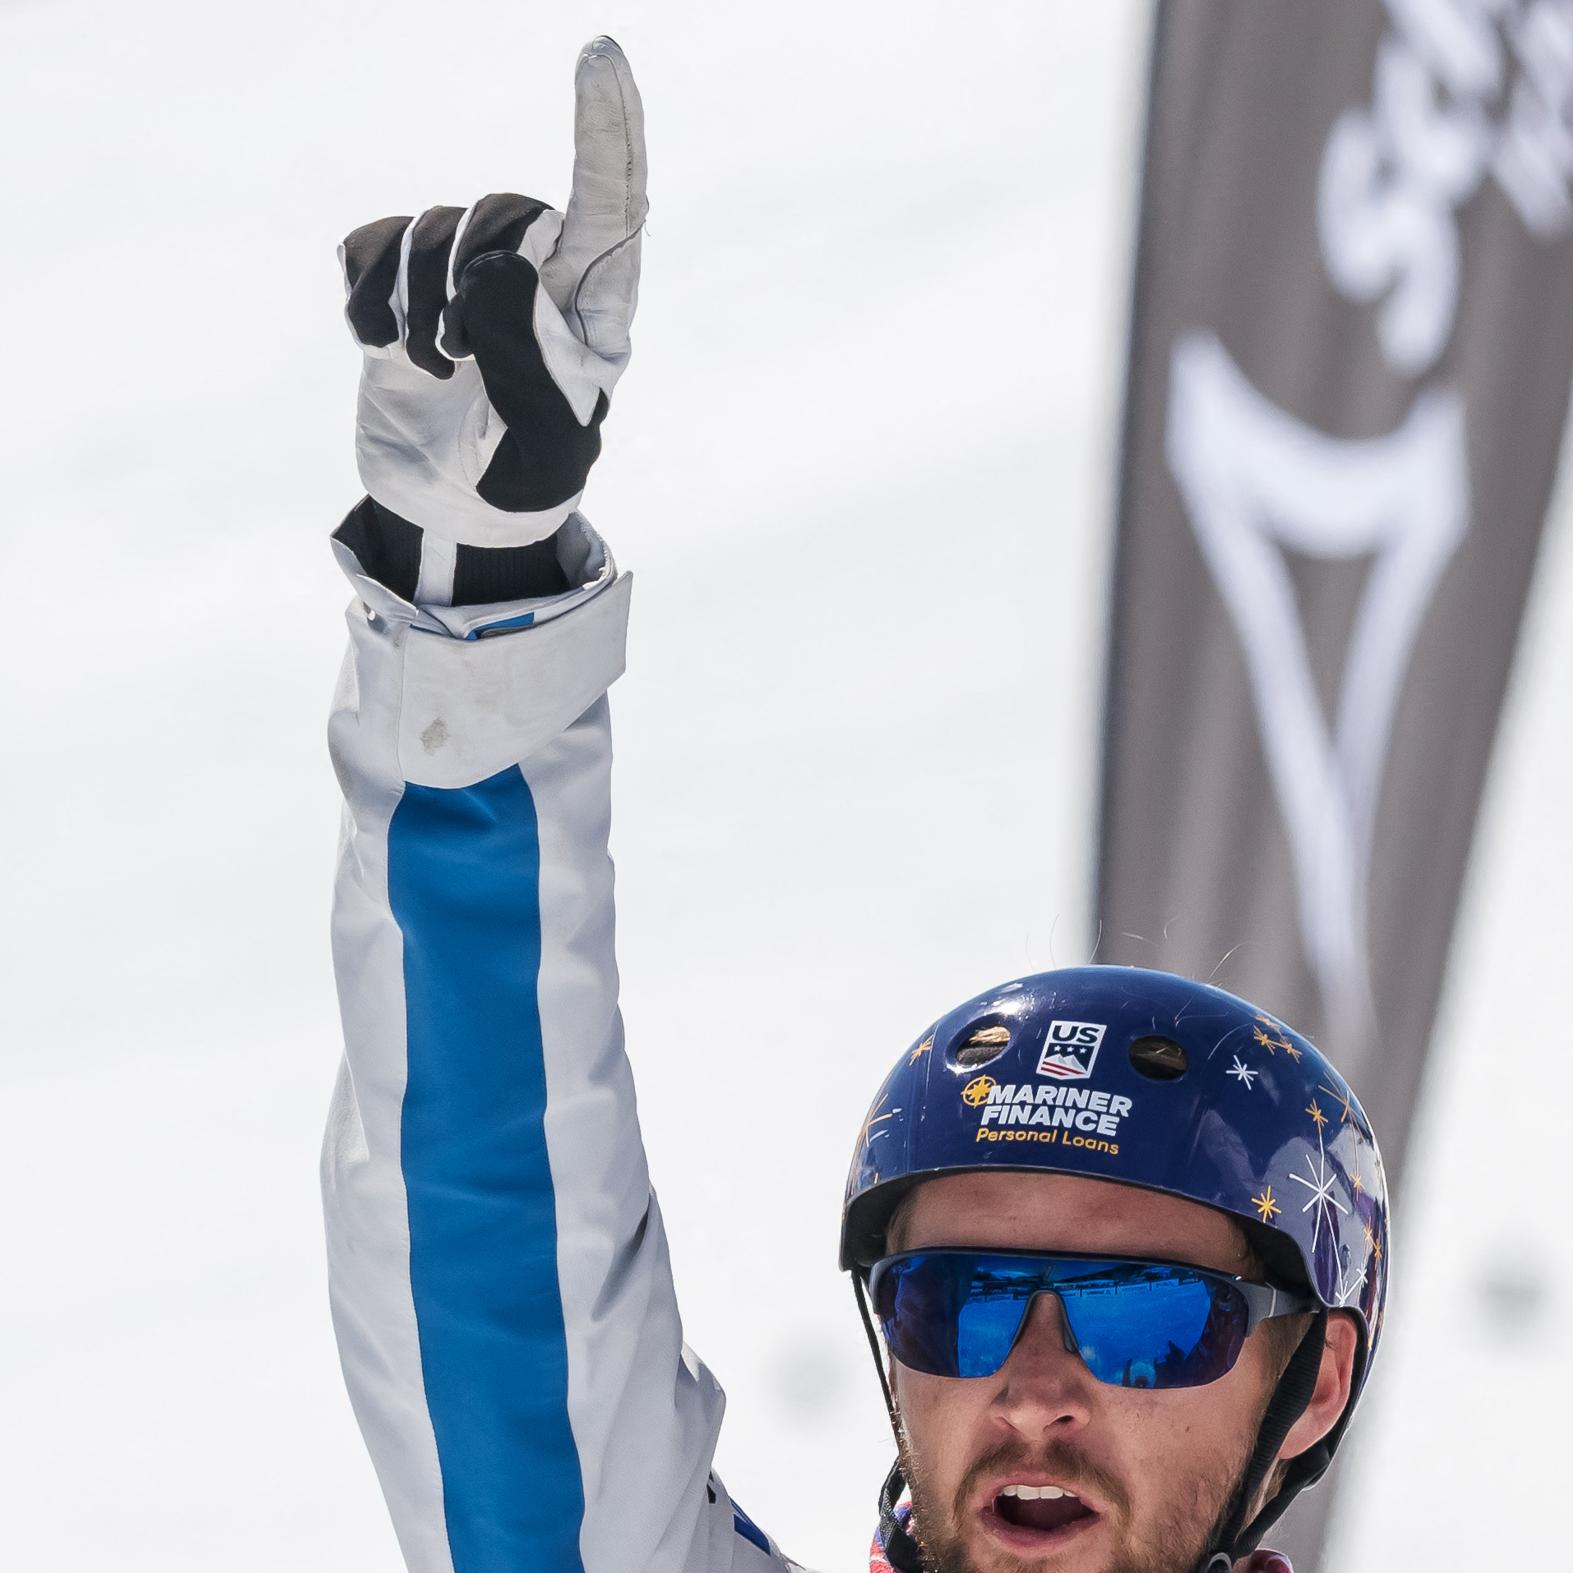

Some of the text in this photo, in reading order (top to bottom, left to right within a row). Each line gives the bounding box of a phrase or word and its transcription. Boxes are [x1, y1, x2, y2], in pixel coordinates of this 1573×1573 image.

[1052, 1025, 1100, 1044] US
[987, 1084, 1133, 1117] MARINER
[981, 1105, 1120, 1137] FINANCE
[976, 1127, 1120, 1155] Personal Loans
